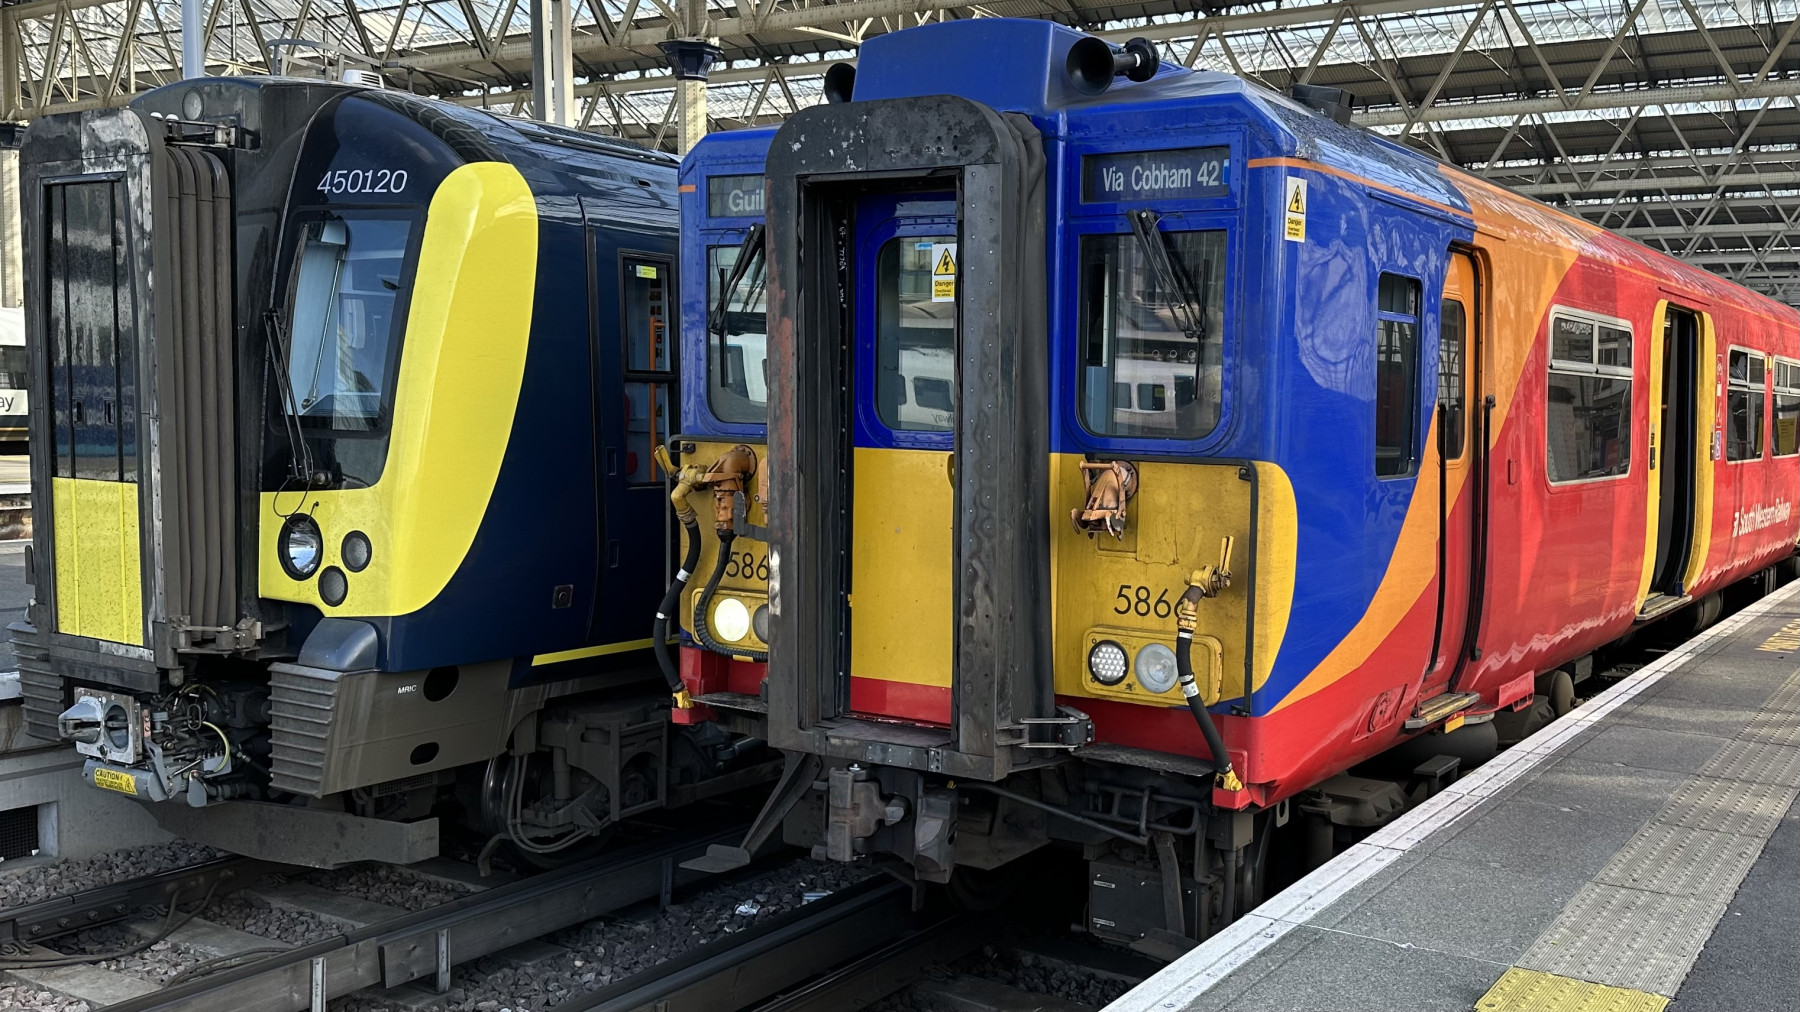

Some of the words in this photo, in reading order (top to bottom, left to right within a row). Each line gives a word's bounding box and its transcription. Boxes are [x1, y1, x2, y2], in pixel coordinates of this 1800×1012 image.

[316, 169, 408, 194] 450120
[1103, 166, 1124, 192] Via
[1131, 163, 1192, 191] Cobham
[1197, 160, 1220, 187] 42
[1287, 217, 1302, 226] Danger
[934, 280, 954, 288] Danger
